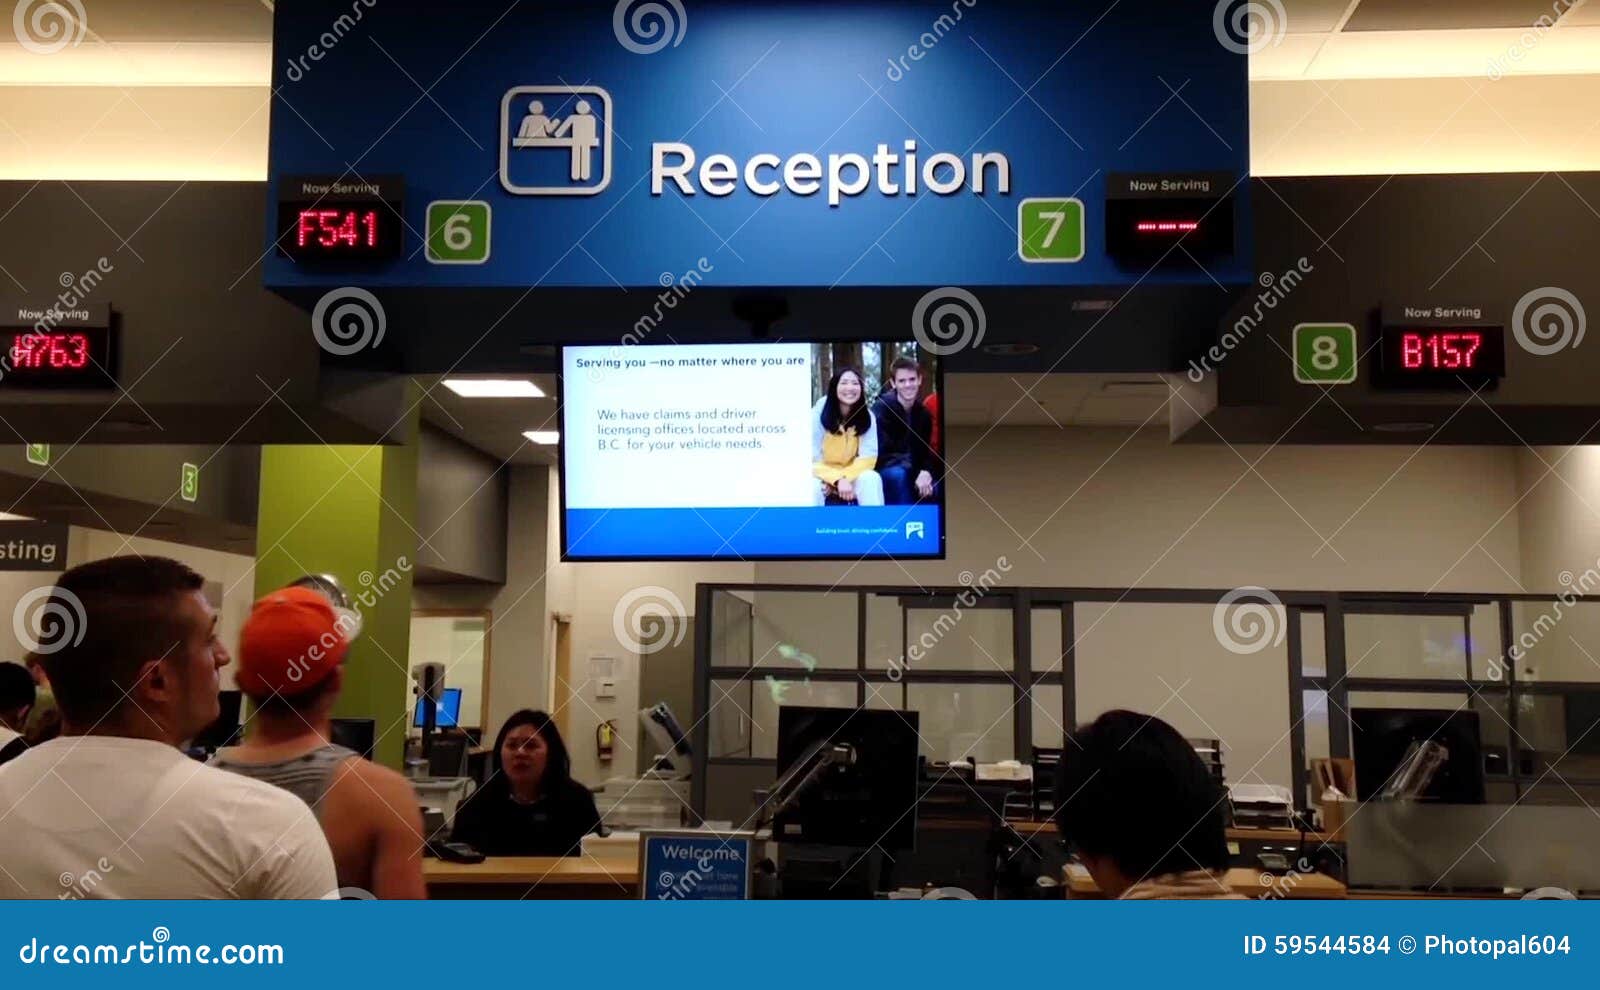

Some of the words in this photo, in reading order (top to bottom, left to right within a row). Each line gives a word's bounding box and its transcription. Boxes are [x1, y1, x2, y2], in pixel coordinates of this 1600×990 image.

[650, 140, 1011, 206] Reception
[302, 183, 328, 194] Now
[334, 183, 379, 195] Serving
[1130, 180, 1156, 191] Now
[1161, 180, 1209, 191] Serving
[298, 211, 377, 246] F541
[443, 214, 472, 250] 6
[1038, 211, 1065, 249] 7
[18, 309, 43, 319] Now
[46, 309, 89, 320] Serving
[1405, 307, 1431, 318] Now
[1435, 307, 1481, 319] Serving
[13, 335, 86, 367] H763
[1311, 335, 1339, 371] 8
[1403, 334, 1481, 368] B157
[576, 358, 621, 369] Serving
[625, 359, 646, 368] you
[678, 358, 717, 367] matter
[721, 356, 757, 366] where
[761, 357, 783, 367] you
[786, 357, 805, 365] are
[597, 409, 617, 420] We
[620, 409, 650, 420] have
[653, 408, 691, 420] claims
[695, 408, 718, 420] and
[597, 424, 650, 438] licensing
[654, 423, 694, 435] offices
[697, 423, 744, 435] located
[747, 425, 786, 434] across
[627, 438, 645, 449] for
[648, 441, 675, 452] your
[679, 438, 722, 449] vehicle
[662, 845, 740, 860] Welcome
